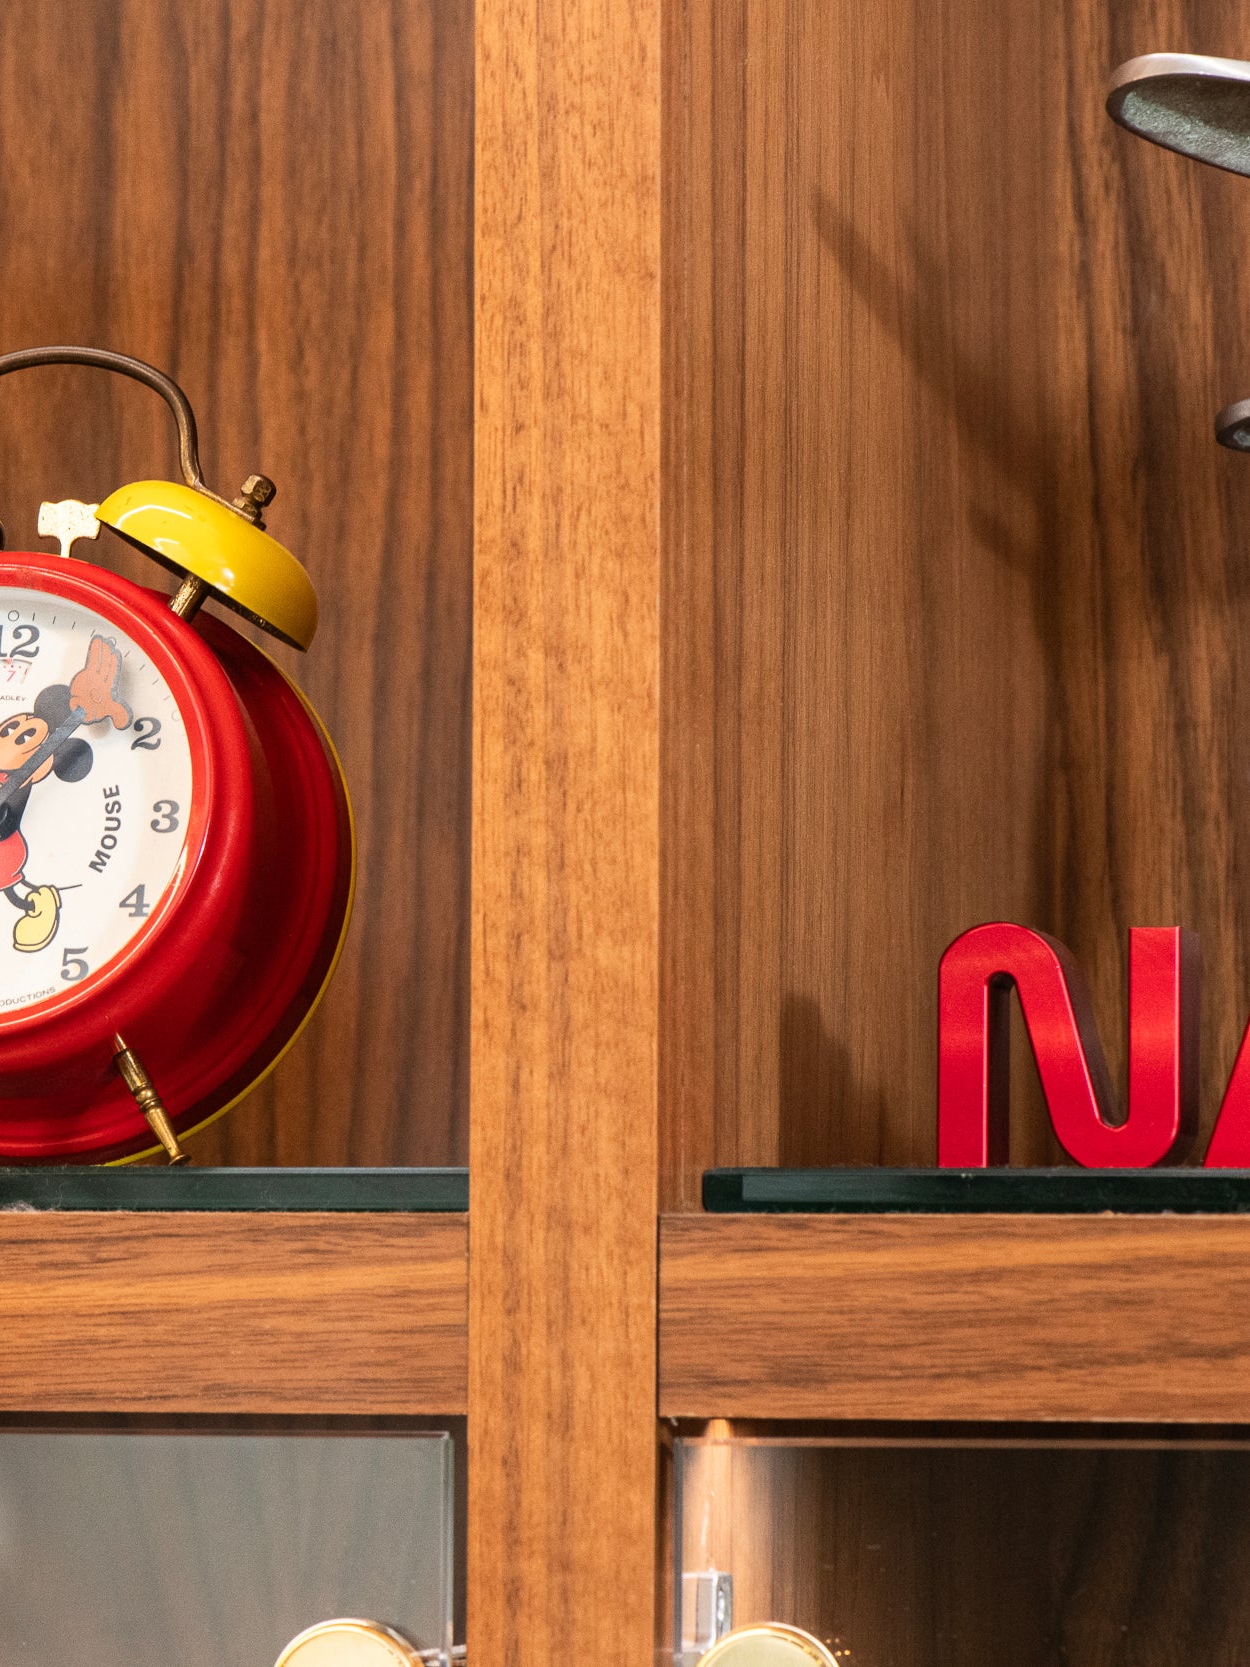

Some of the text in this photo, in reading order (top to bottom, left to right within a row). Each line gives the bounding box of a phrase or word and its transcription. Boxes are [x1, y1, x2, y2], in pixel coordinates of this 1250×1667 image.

[131, 716, 162, 751] 2
[88, 784, 122, 873] MOUSE
[150, 799, 181, 834] 3
[118, 884, 151, 918] 4
[60, 947, 90, 982] 5
